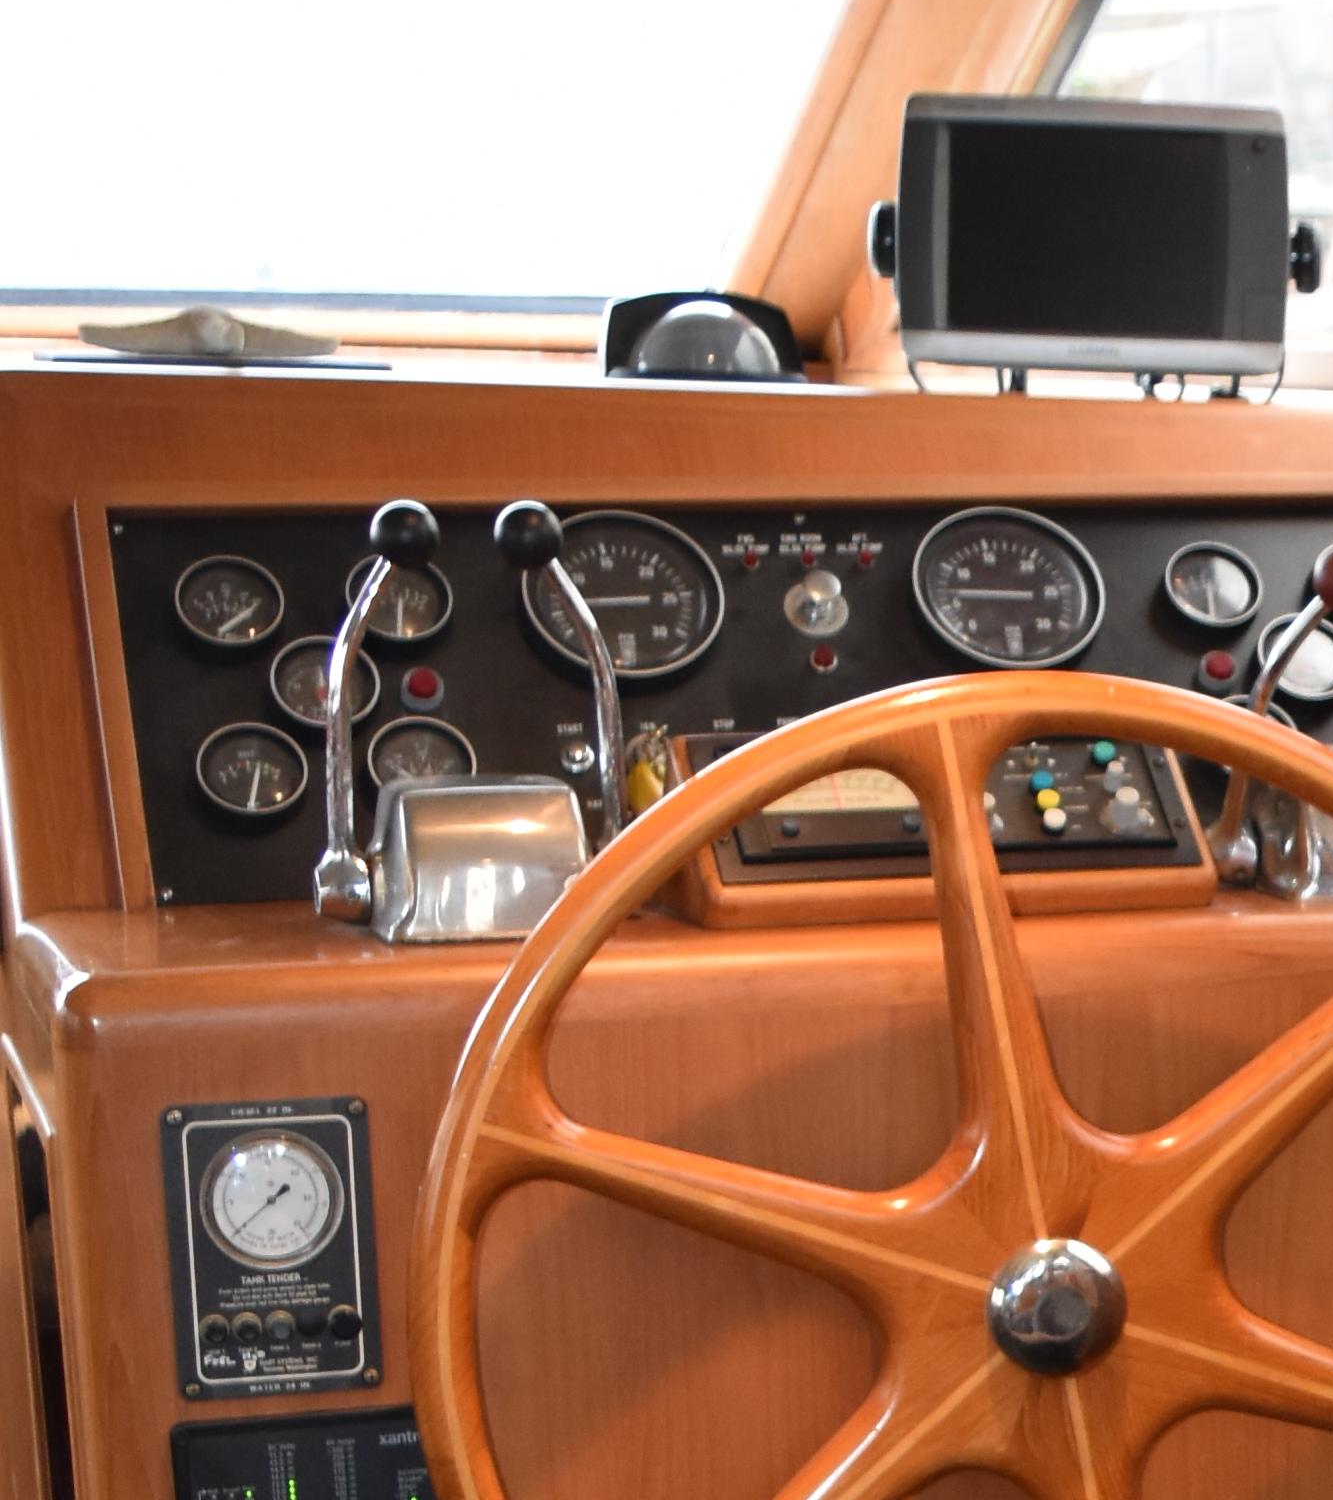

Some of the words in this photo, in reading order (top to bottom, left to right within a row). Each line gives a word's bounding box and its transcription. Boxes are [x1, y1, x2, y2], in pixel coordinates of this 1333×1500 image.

[601, 556, 614, 570] 15
[983, 552, 996, 566] 15
[639, 566, 654, 579] 20
[1020, 560, 1035, 573] 20
[662, 591, 677, 605] 25
[1044, 585, 1058, 598] 25
[1035, 617, 1052, 631] 30
[652, 625, 668, 638] 30
[241, 1275, 265, 1285] TANK
[267, 1272, 301, 1284] TENDER
[379, 1430, 418, 1446] xantr
